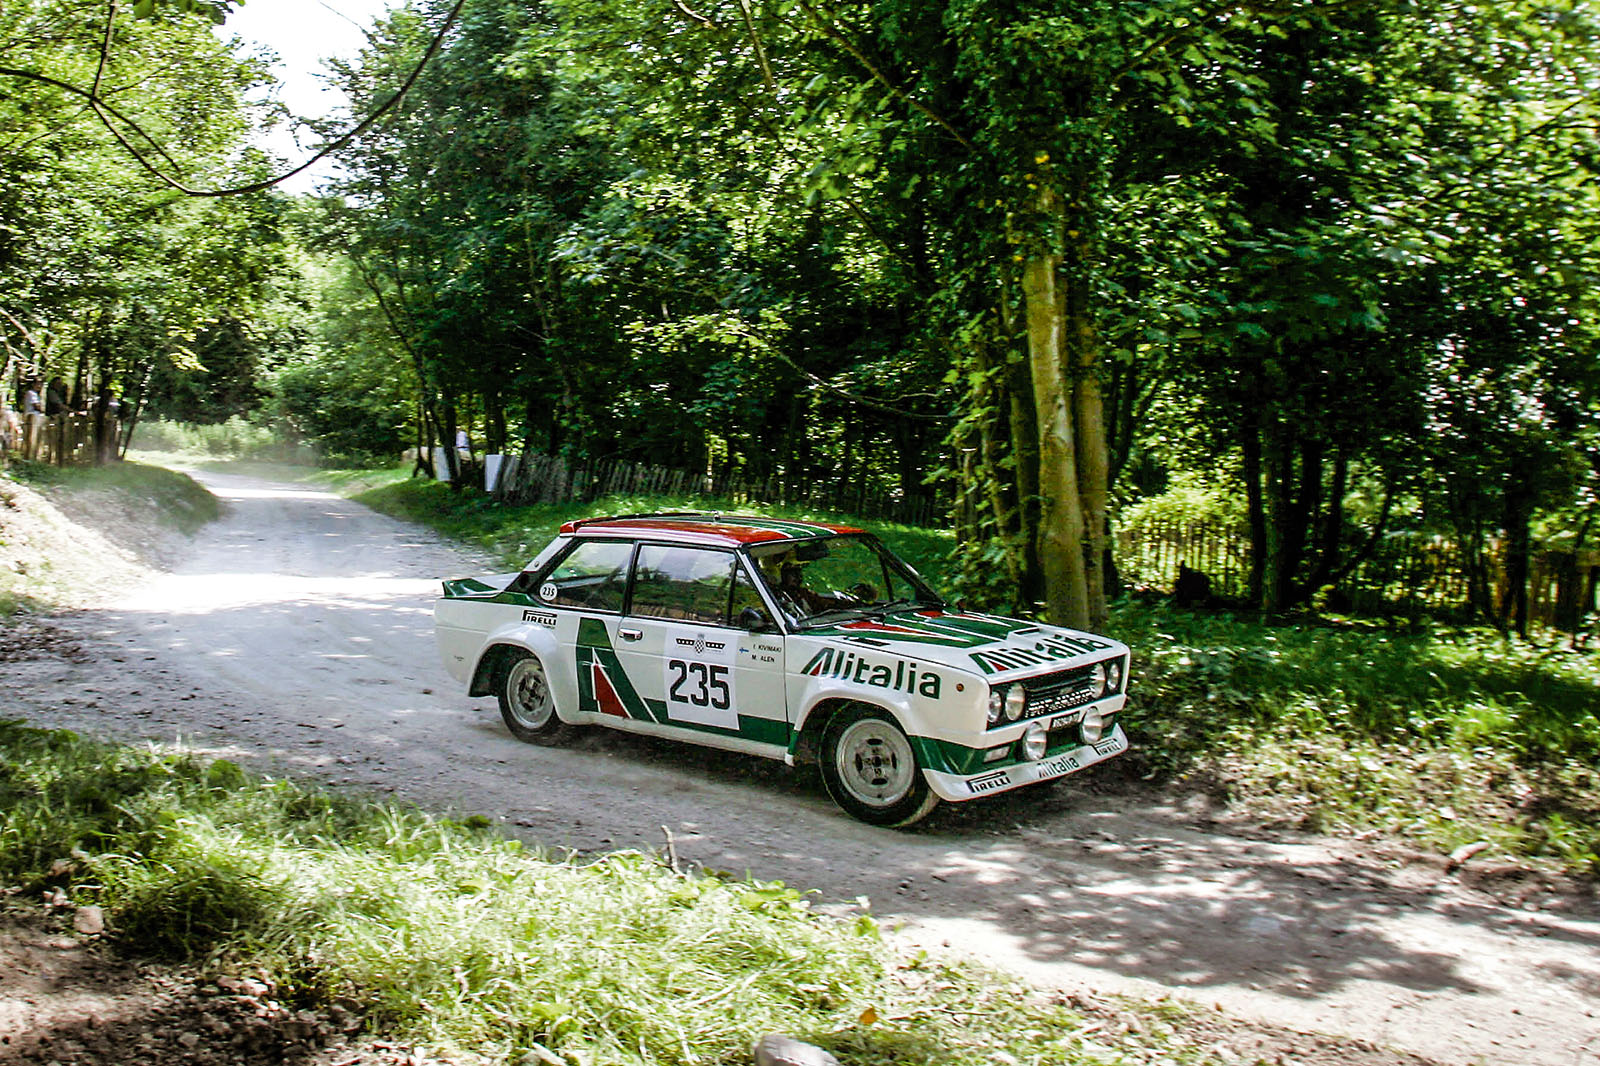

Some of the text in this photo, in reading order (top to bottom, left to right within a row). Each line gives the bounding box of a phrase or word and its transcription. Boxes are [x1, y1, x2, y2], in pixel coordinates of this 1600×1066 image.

[542, 586, 556, 597] 235
[522, 609, 558, 626] PIRELLI
[968, 634, 1113, 675] Alitalia
[800, 647, 942, 699] Alitalia
[669, 659, 731, 710] 235
[1092, 737, 1123, 757] PIRELLI
[1038, 756, 1080, 779] Alitalia
[967, 771, 1012, 793] PIRELLI
